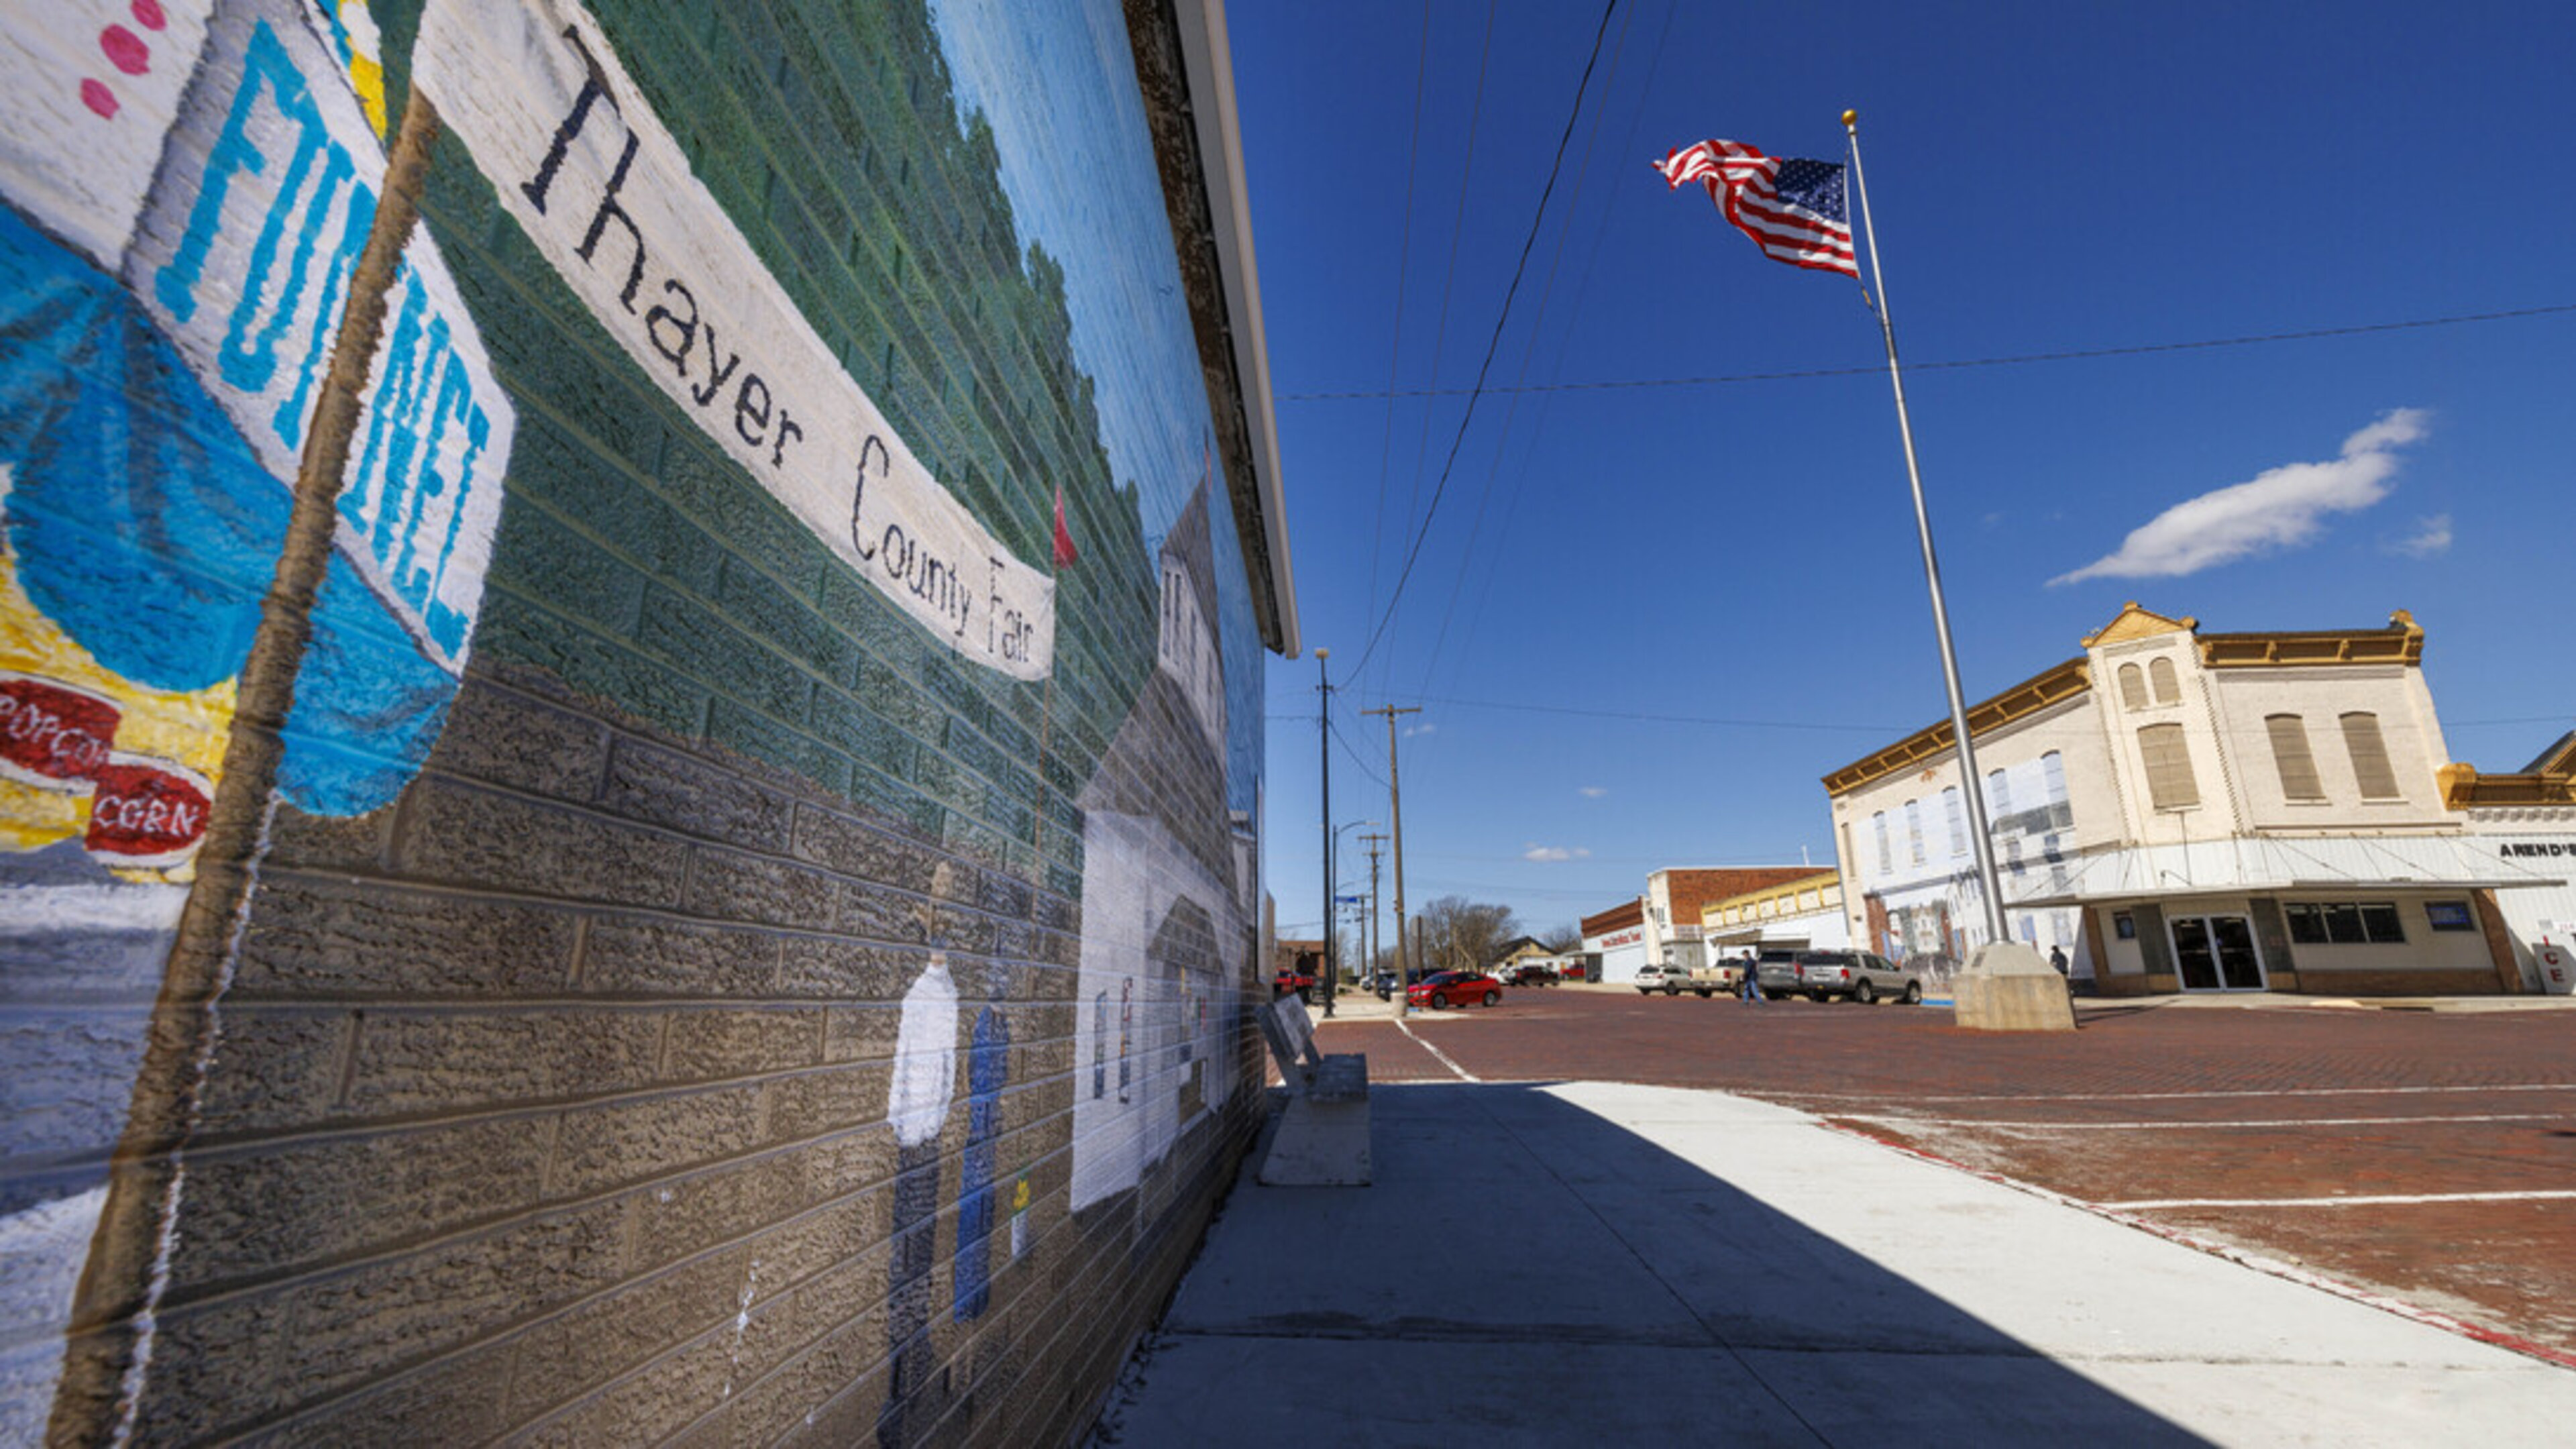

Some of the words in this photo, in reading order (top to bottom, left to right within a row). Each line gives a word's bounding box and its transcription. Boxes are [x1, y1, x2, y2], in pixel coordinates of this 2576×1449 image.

[520, 24, 803, 469] Thayer
[852, 435, 971, 637] County
[988, 555, 1034, 663] Fair
[2542, 935, 2565, 983] ICE
